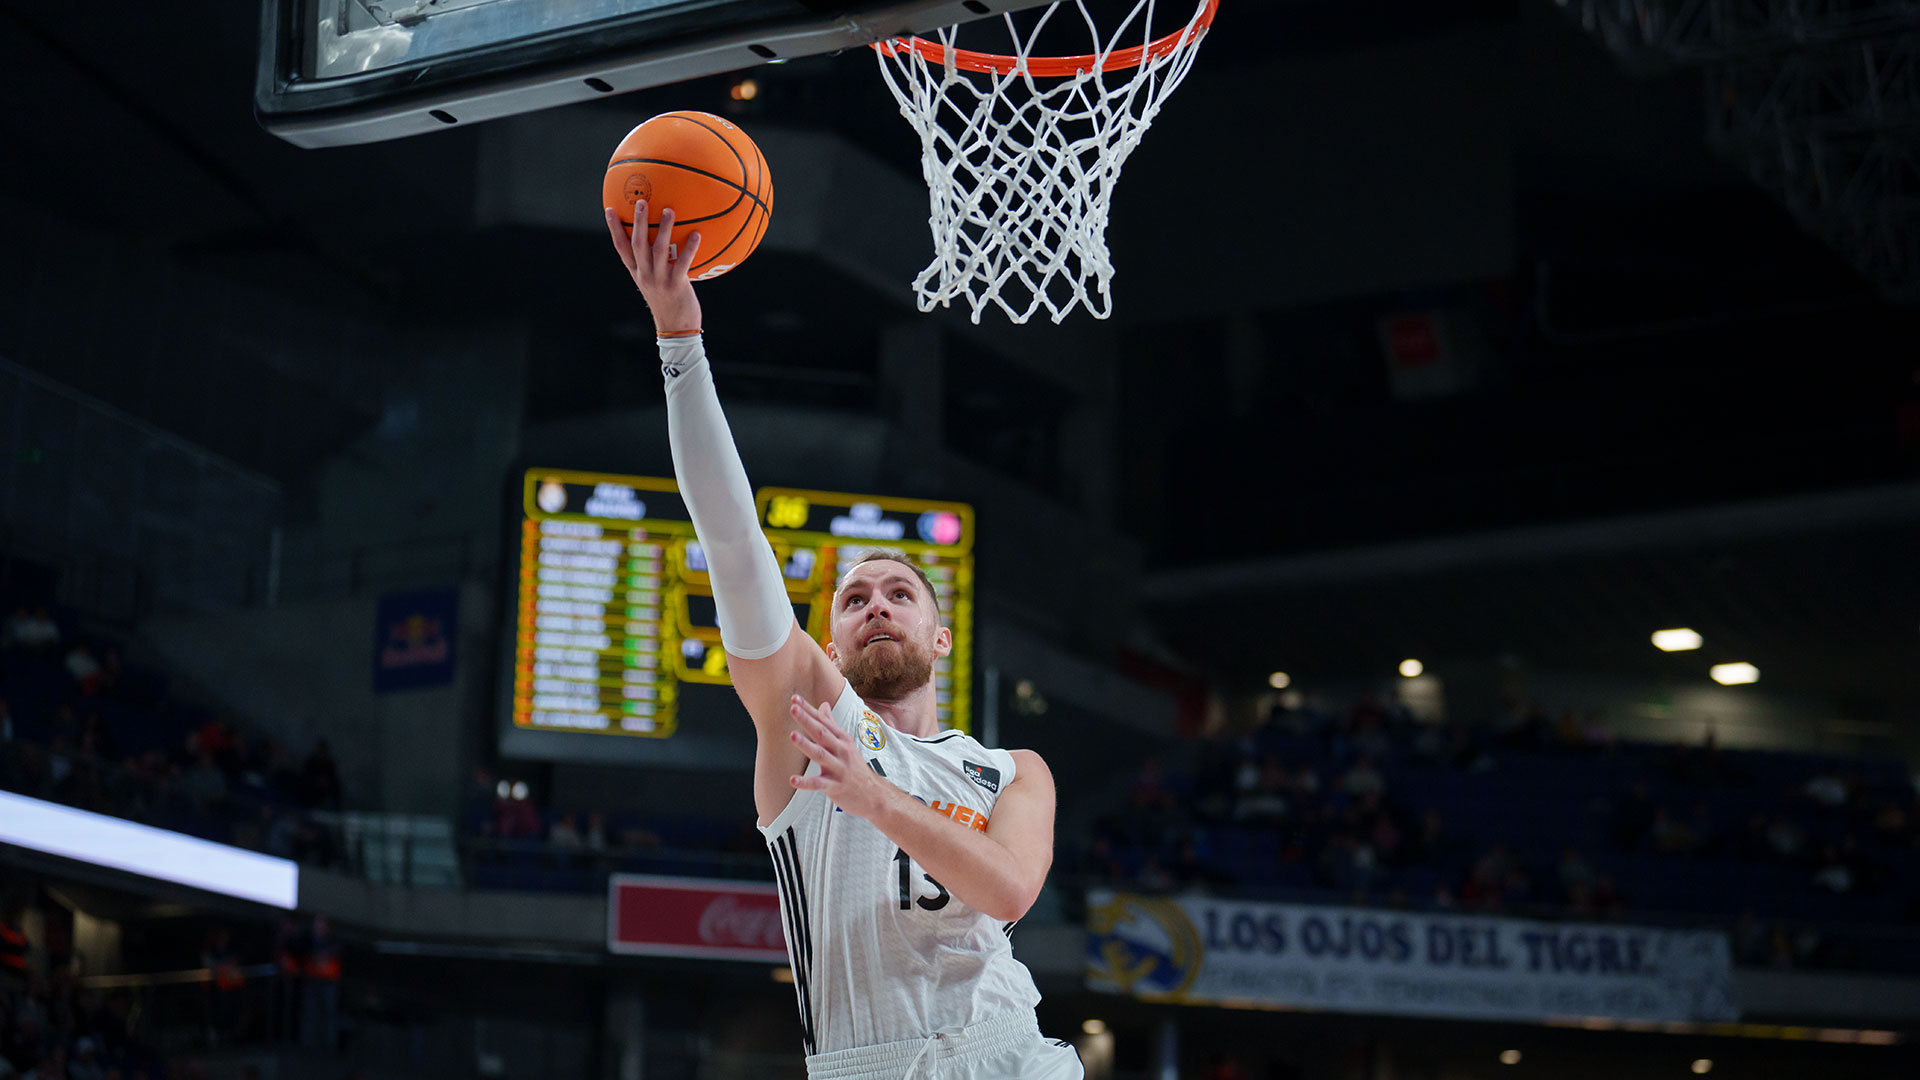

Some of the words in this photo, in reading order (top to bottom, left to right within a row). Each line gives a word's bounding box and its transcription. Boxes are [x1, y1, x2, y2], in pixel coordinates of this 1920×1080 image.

[1204, 908, 1285, 954] LOS
[1301, 916, 1412, 963] OJOS
[1426, 923, 1506, 968] DEL
